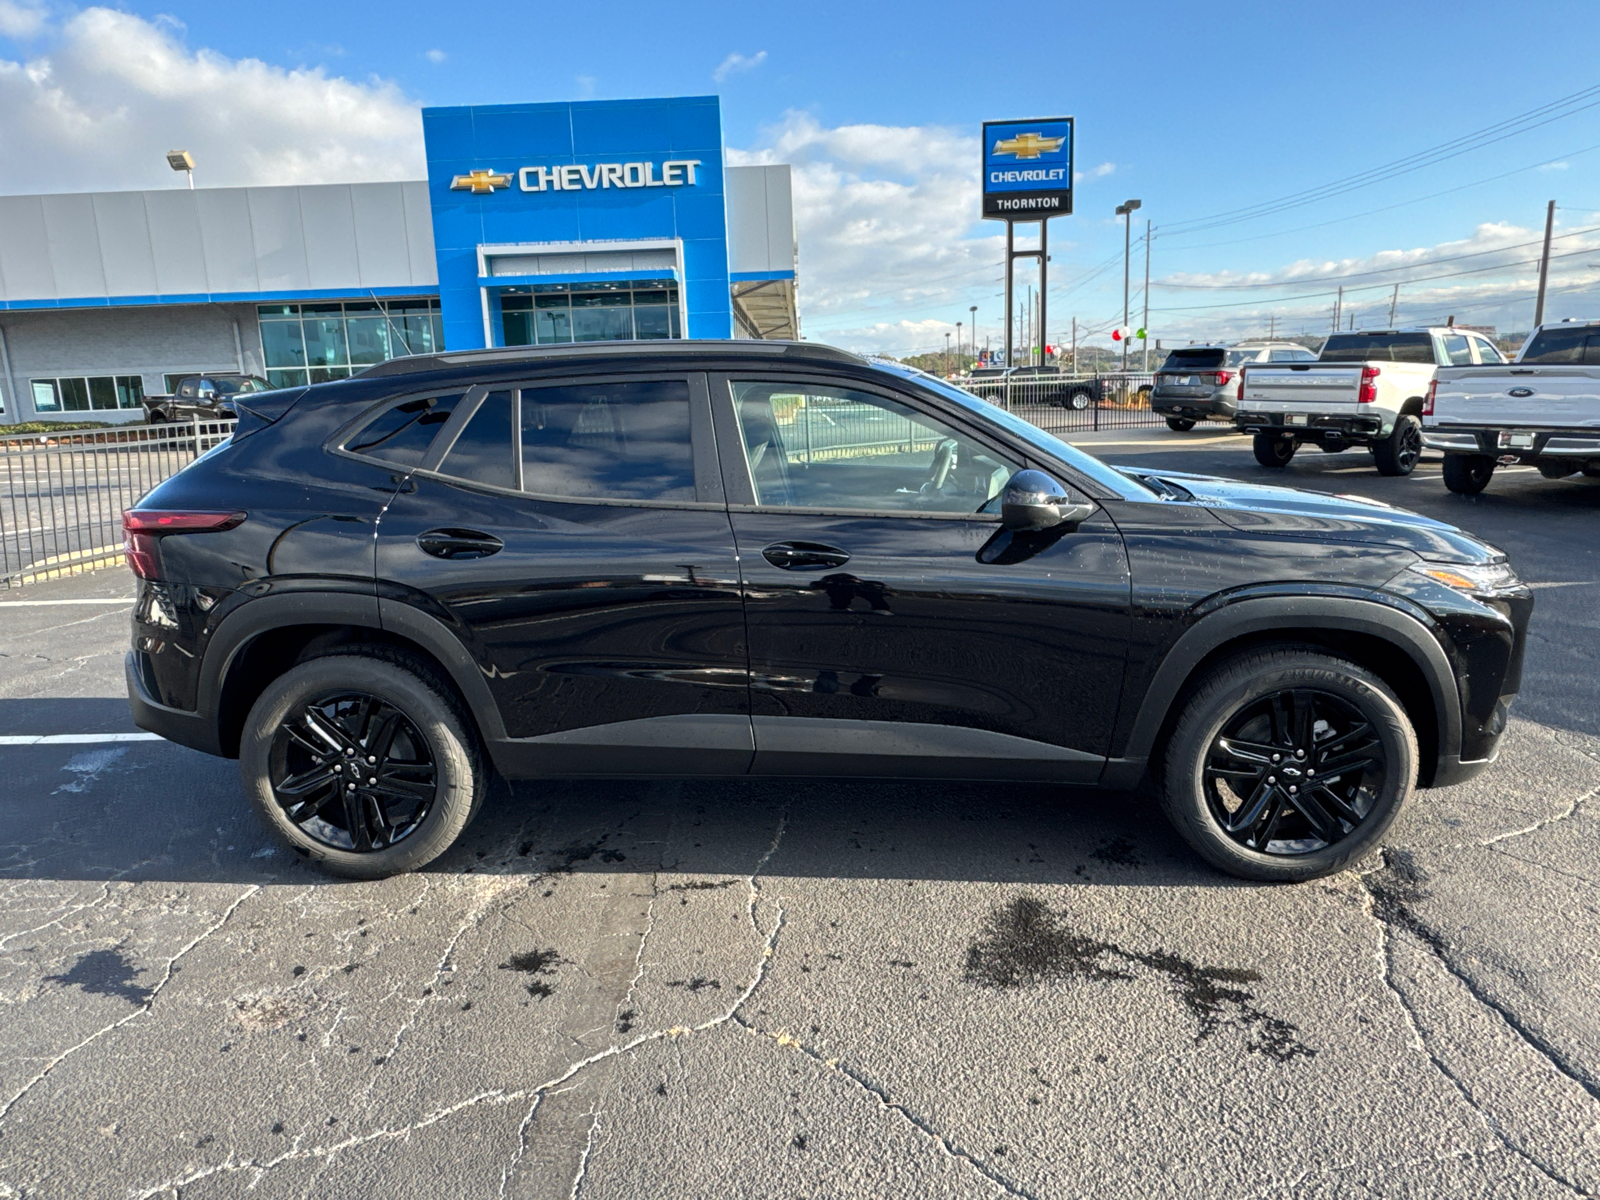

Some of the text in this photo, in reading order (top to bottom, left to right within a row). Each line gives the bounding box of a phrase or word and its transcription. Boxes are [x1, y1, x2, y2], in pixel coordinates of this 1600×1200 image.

[519, 160, 700, 192] CHEVROLET
[990, 168, 1065, 183] CHEVROLET
[997, 197, 1059, 210] THORNTON
